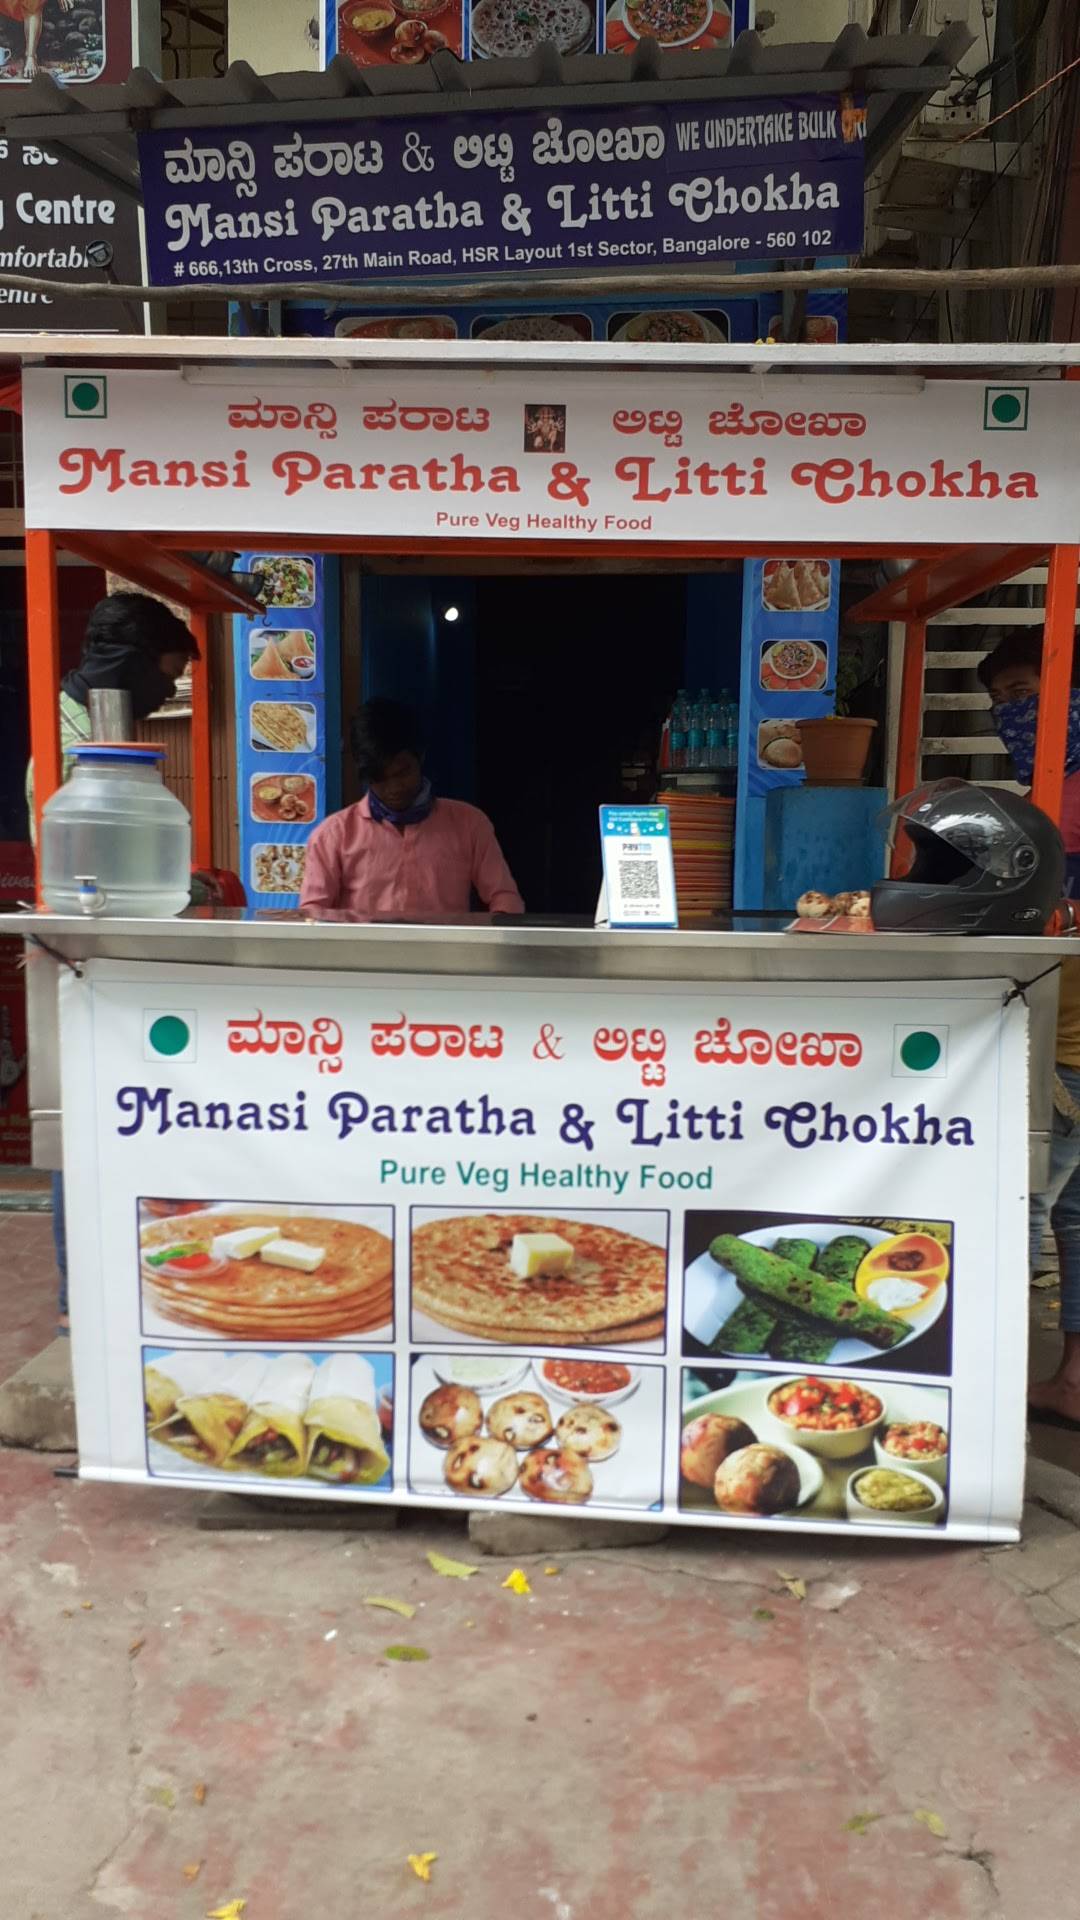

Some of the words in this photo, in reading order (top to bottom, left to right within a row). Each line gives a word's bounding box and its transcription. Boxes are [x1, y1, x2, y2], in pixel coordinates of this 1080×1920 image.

[675, 121, 700, 151] WE
[704, 112, 794, 148] UNDERTAKE
[798, 110, 837, 140] BULK
[164, 137, 258, 199] ಮಾನ್ಸಿ
[273, 131, 383, 178] ಪರಾಟ
[402, 132, 434, 172] &
[16, 192, 116, 225] Centre
[165, 198, 299, 251] Mansi
[311, 190, 484, 242] Paratha
[501, 193, 532, 237] &
[547, 181, 653, 229] Litti
[668, 172, 840, 223] Chokha
[174, 261, 184, 277] #
[263, 256, 318, 273] Cross,
[322, 253, 358, 270] 27th
[363, 251, 403, 268] Main
[408, 248, 457, 266] Road,
[462, 246, 499, 263] HSR
[504, 243, 562, 264] Layout
[568, 242, 593, 258] 1st
[598, 239, 658, 257] Sector,
[663, 236, 750, 255] Bangalore
[766, 232, 796, 248] 560
[802, 229, 832, 245] 102
[228, 396, 338, 440] ಮಾನ್ಸಿ
[362, 398, 489, 433] ಪರಾಟ
[59, 447, 251, 495] Mansi
[272, 450, 521, 496] Paratha
[547, 461, 591, 507] &
[615, 456, 768, 503] Litti
[791, 457, 1039, 505] Chokha
[436, 512, 479, 527] Pure
[485, 513, 520, 531] Veg
[527, 514, 598, 532] Healthy
[604, 515, 652, 530] Food
[227, 1008, 343, 1074] ಮಾನ್ಸಿ
[370, 1010, 504, 1059] ಪರಾಟ
[532, 1023, 565, 1060] &
[116, 1086, 309, 1136] Manasi
[328, 1091, 537, 1139] Paratha
[559, 1104, 595, 1151] &
[616, 1098, 744, 1147] Litti
[764, 1101, 974, 1149] Chokha
[380, 1159, 446, 1185] Pure
[457, 1161, 509, 1193] Veg
[520, 1163, 629, 1195] Healthy
[640, 1165, 713, 1190] Food
